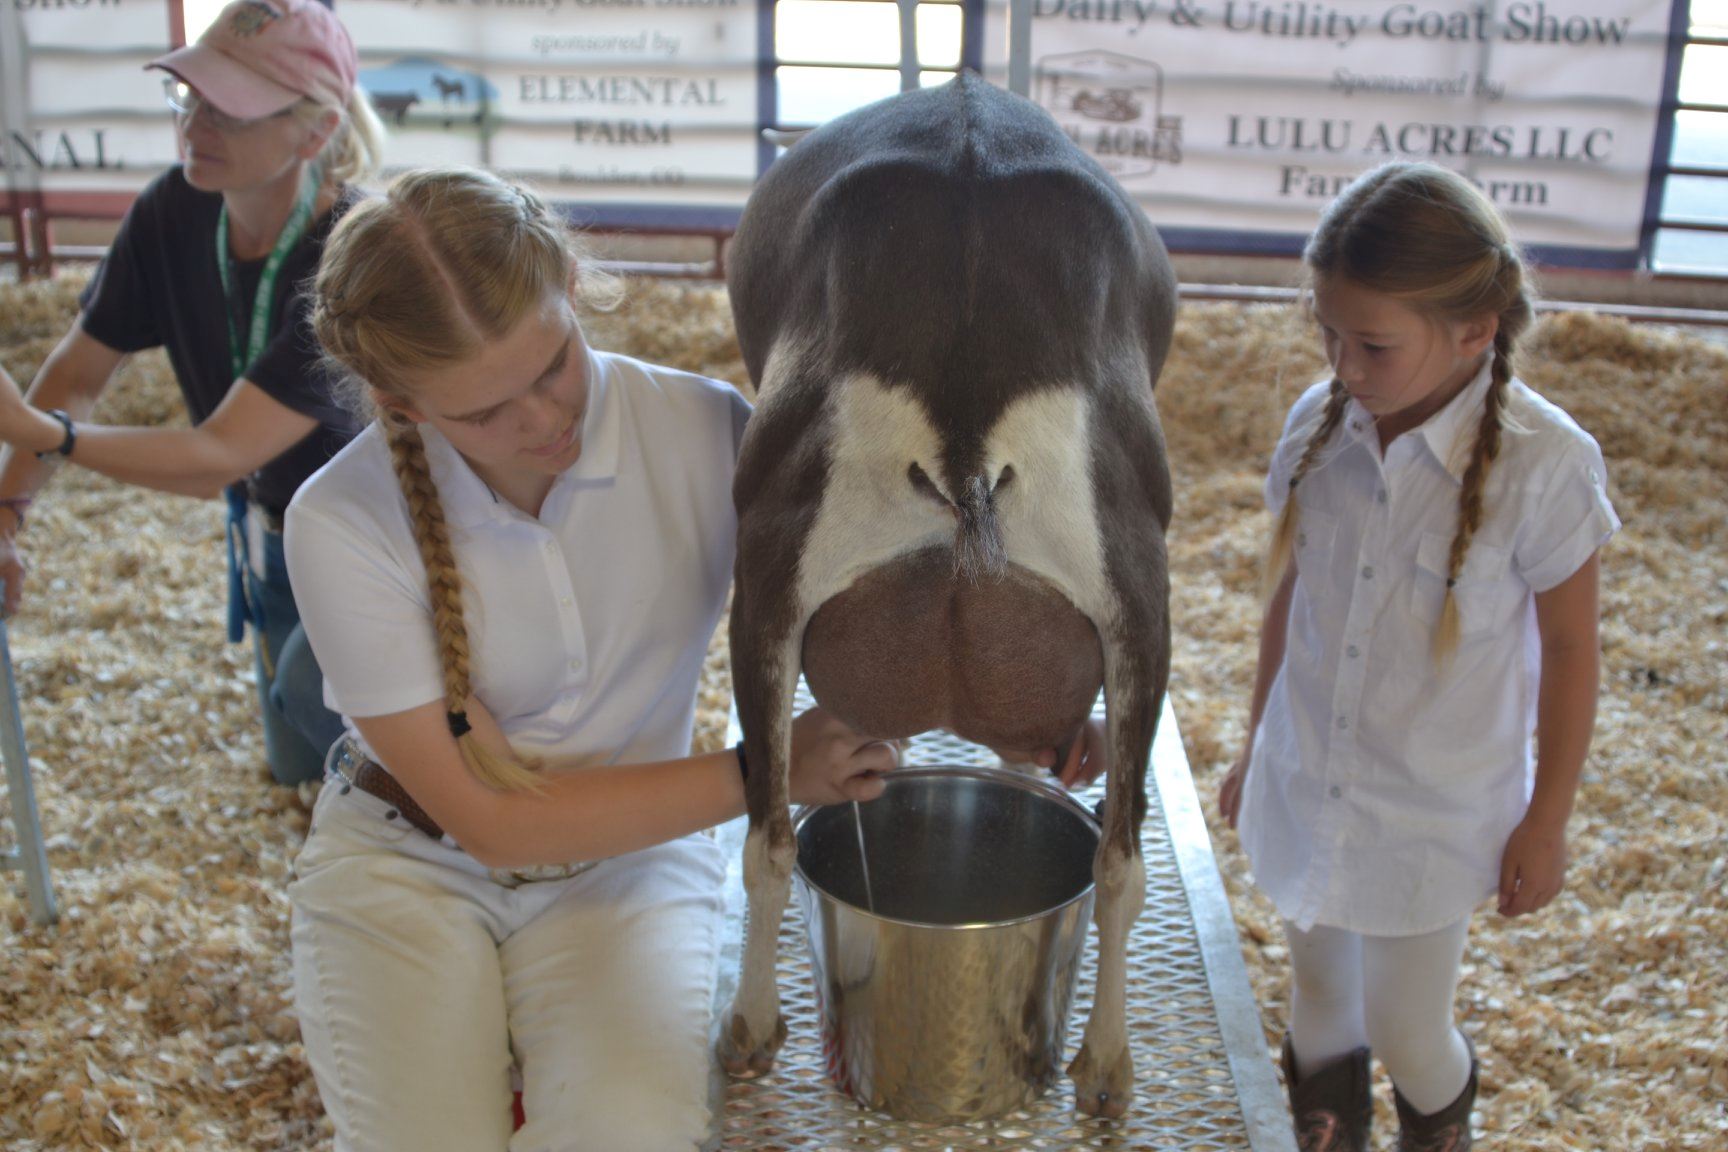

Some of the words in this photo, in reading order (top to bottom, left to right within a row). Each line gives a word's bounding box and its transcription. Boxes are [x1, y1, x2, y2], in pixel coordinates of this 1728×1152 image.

[1167, 0, 1204, 27] &
[1223, 0, 1368, 47] Utility
[1381, 4, 1490, 42] Goat
[1502, 3, 1631, 46] Show
[532, 30, 647, 54] sponsored
[653, 31, 681, 56] by
[519, 76, 726, 104] ELEMENTAL
[1330, 66, 1470, 97] Sponsored
[1474, 75, 1505, 103] by
[0, 129, 125, 170] NAL
[573, 119, 672, 145] FARM
[1228, 114, 1352, 155] LULU
[1364, 121, 1516, 159] ACRES
[1524, 126, 1614, 162] LLC
